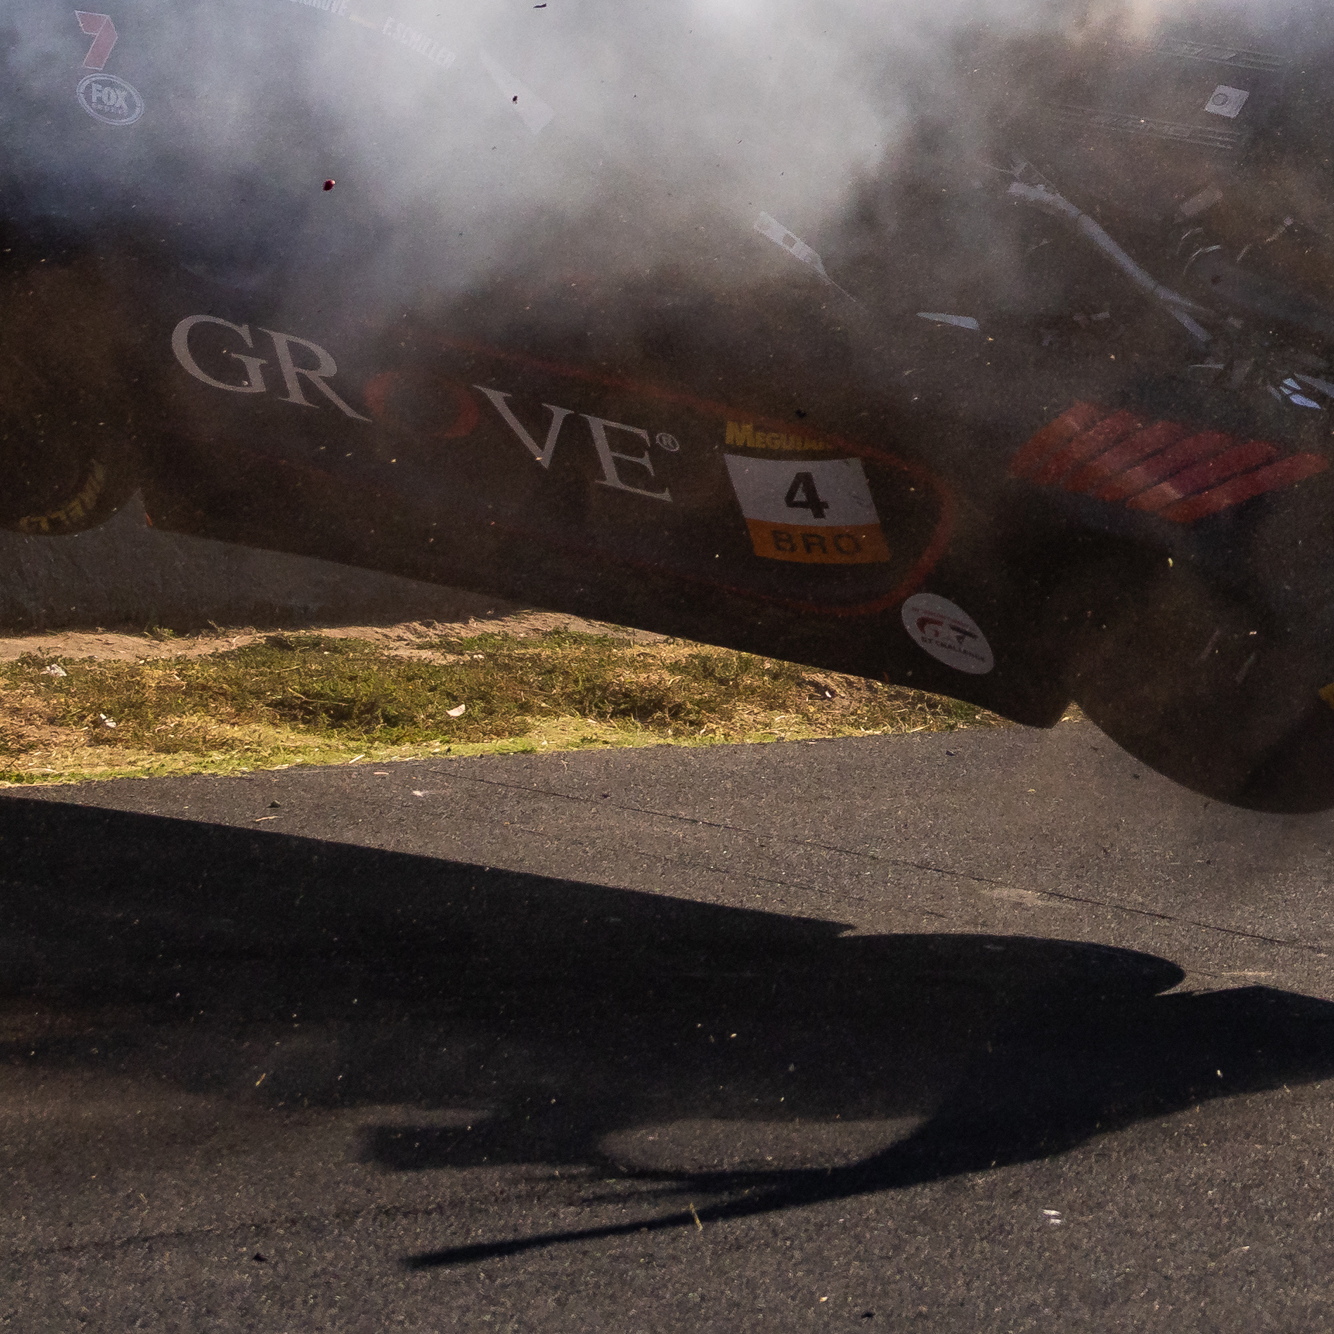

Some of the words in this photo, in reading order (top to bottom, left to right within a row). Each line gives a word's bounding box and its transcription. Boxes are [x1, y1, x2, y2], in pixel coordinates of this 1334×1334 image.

[91, 82, 128, 117] FOX
[786, 472, 829, 518] 4
[771, 529, 862, 555] BRO
